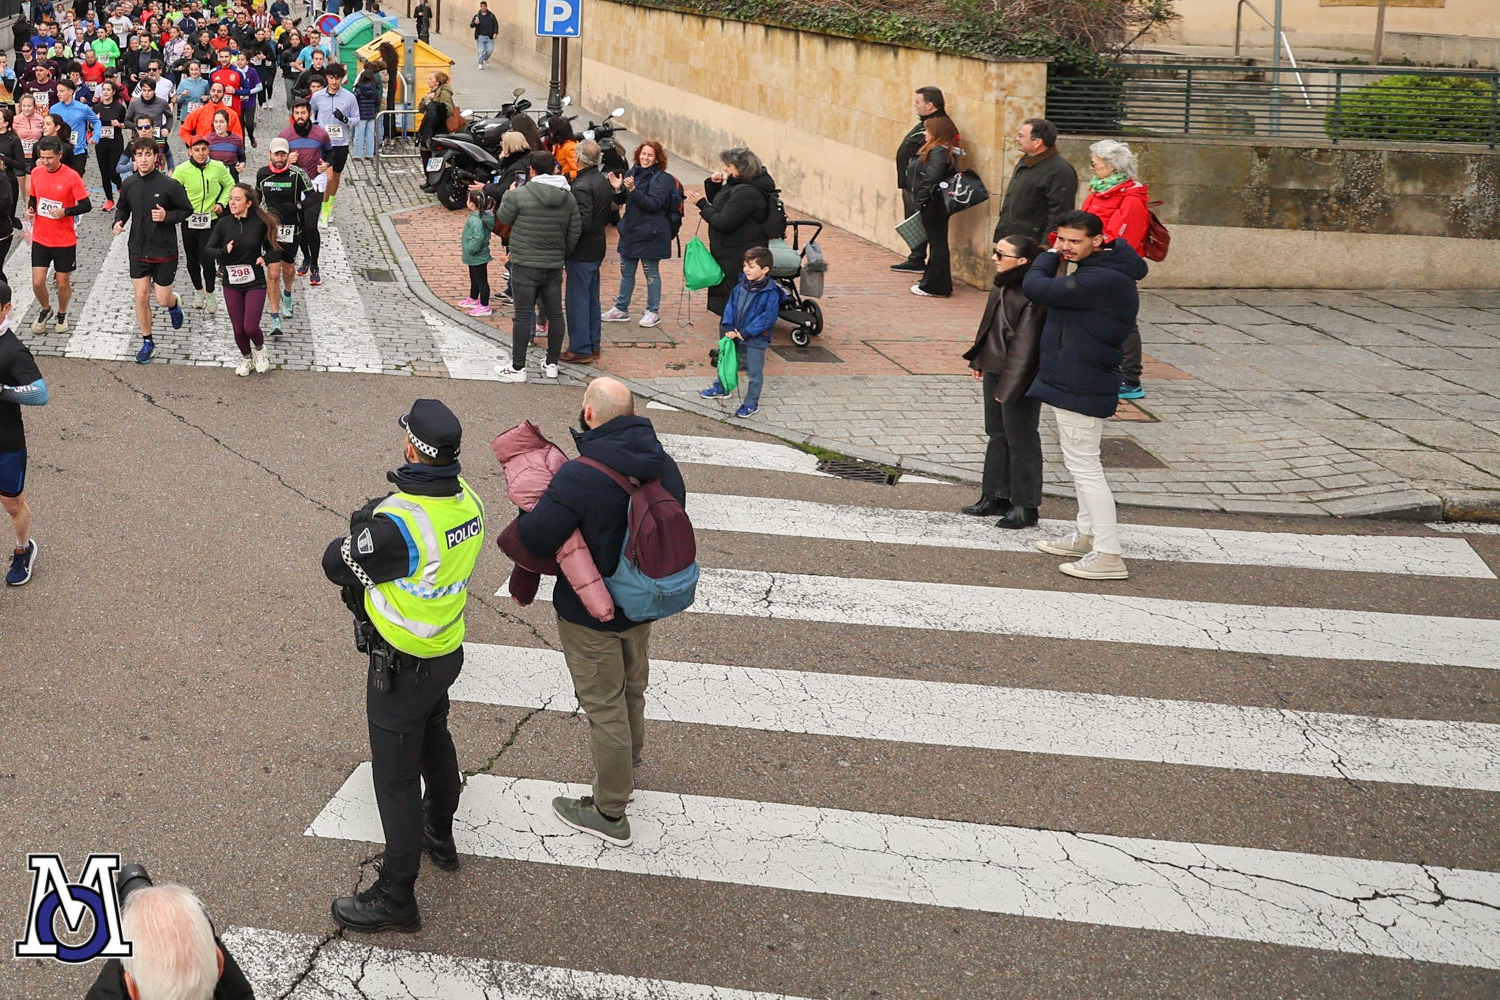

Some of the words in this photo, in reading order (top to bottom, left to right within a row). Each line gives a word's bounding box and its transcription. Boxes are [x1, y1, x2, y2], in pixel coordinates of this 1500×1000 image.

[544, 0, 573, 32] P
[192, 215, 208, 223] 218
[231, 267, 250, 277] 298
